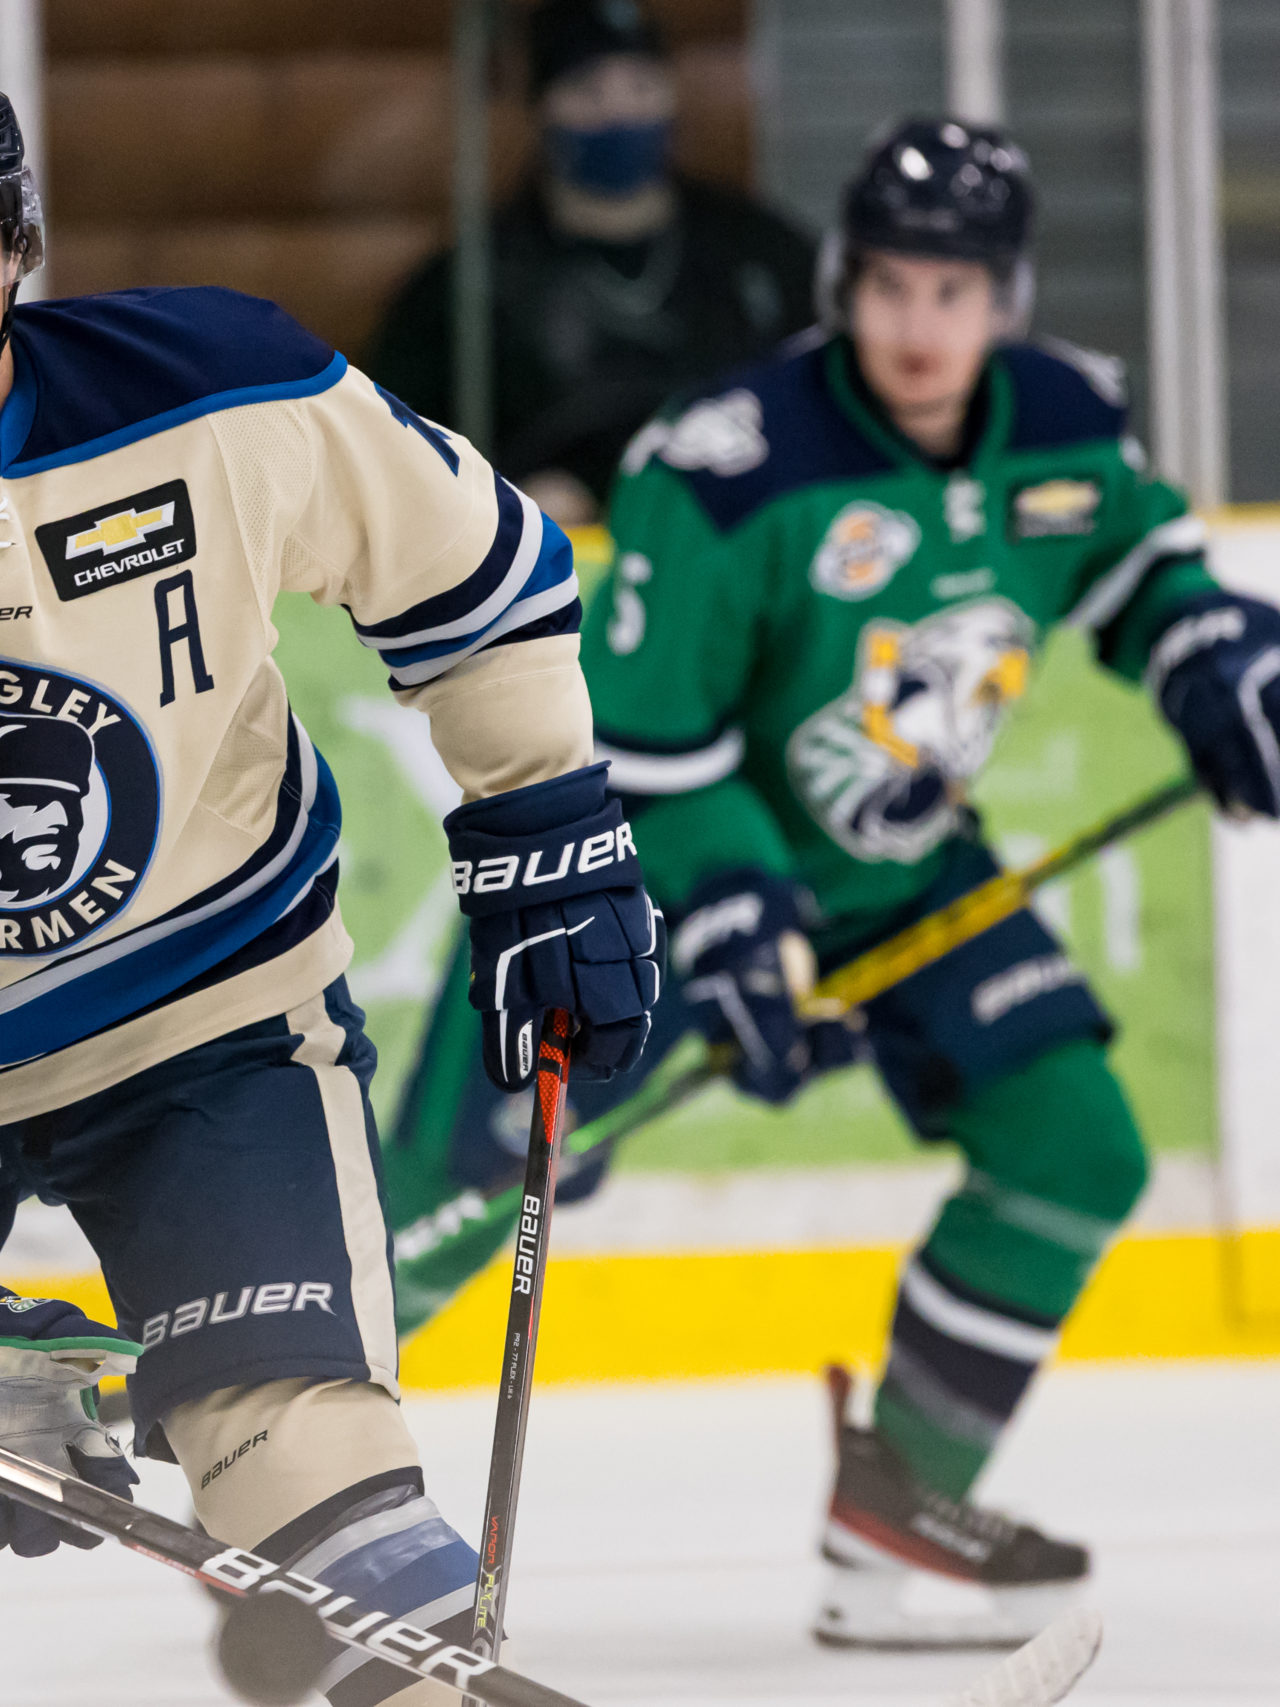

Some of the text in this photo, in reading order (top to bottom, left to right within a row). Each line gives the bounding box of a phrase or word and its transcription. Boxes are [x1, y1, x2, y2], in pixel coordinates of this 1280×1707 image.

[74, 539, 185, 587] CHEVROLET
[154, 569, 214, 708] A
[451, 822, 637, 894] BAUER
[514, 1195, 540, 1294] BAUER
[143, 1282, 337, 1350] BAUER
[201, 1429, 268, 1490] BAUER
[488, 1515, 499, 1564] VAPOR
